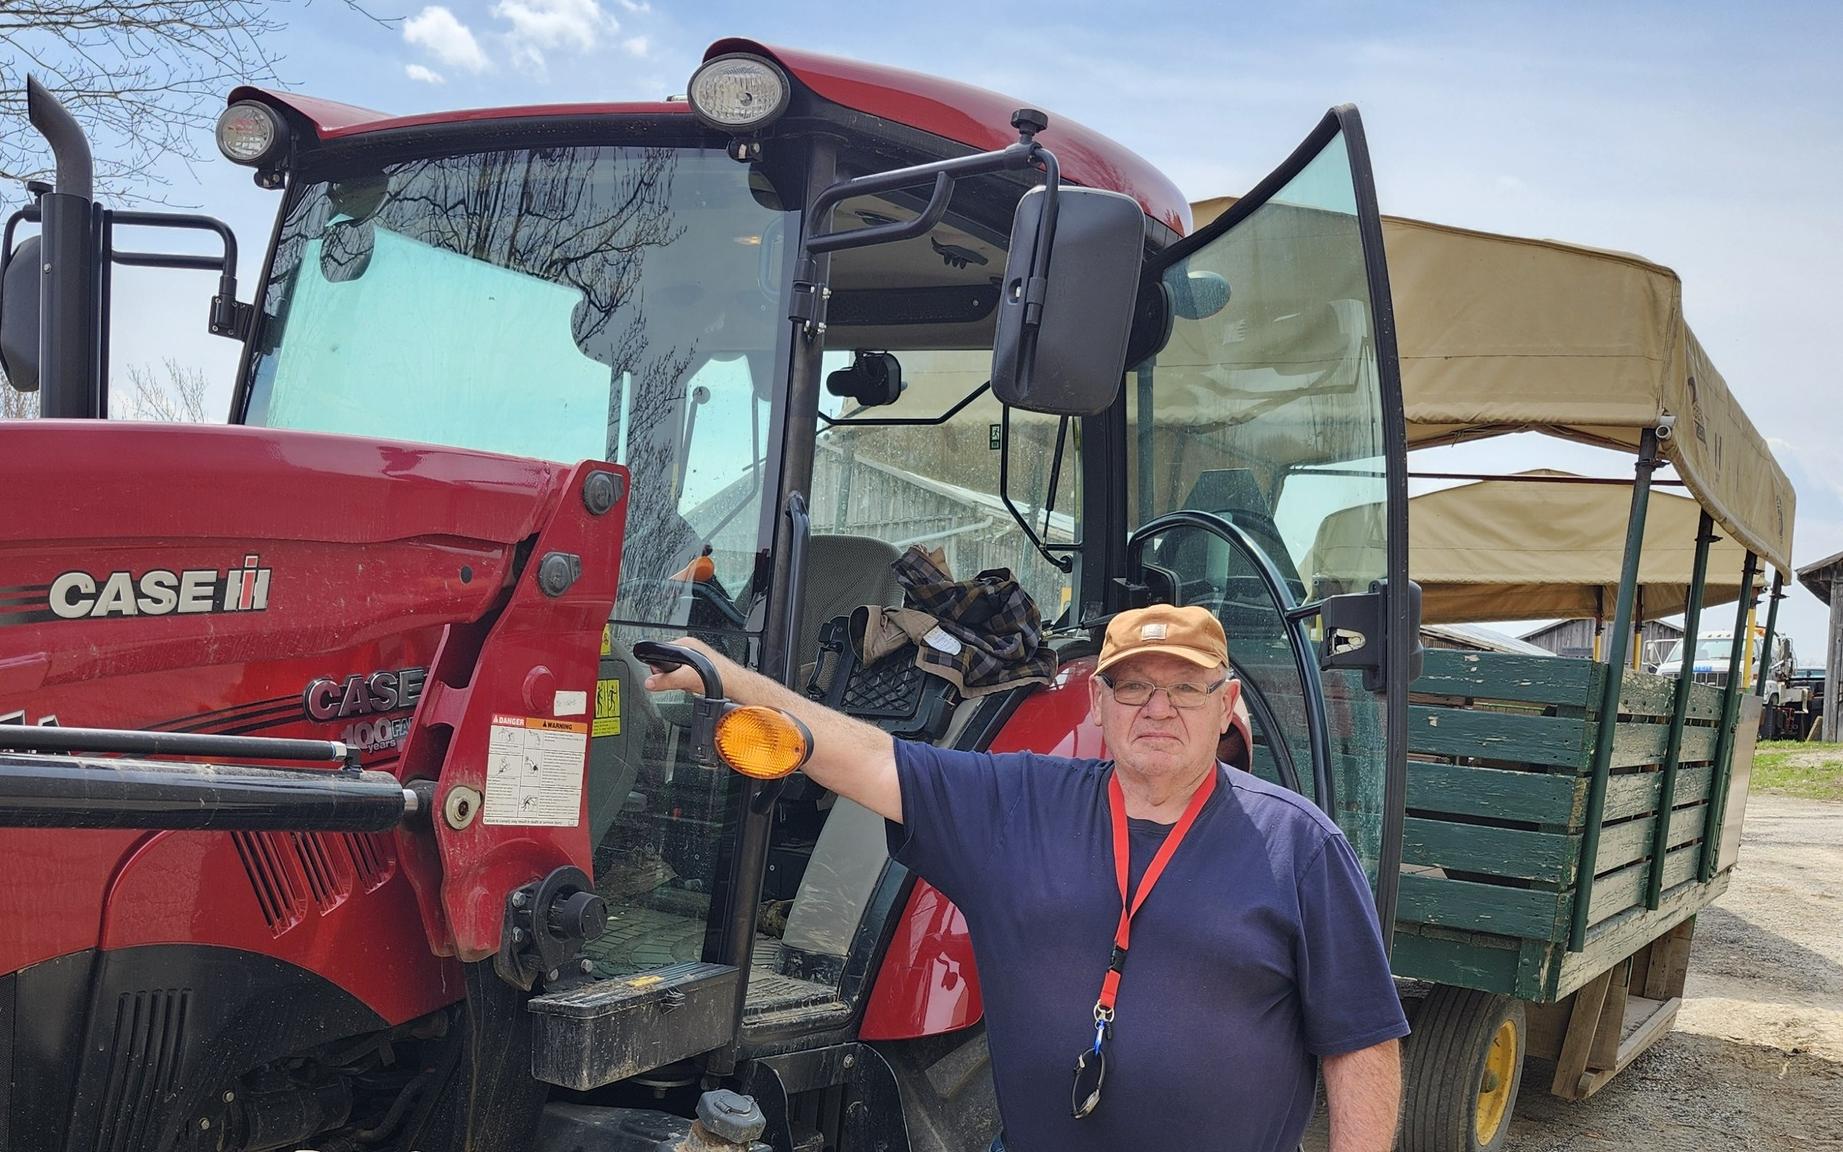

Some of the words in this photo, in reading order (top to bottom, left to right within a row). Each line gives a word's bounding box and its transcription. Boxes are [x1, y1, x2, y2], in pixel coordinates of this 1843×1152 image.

[49, 570, 218, 619] CASE
[306, 668, 425, 721] CASE
[499, 716, 525, 726] DANGER
[547, 721, 573, 730] WARNING
[341, 717, 392, 750] 100
[368, 738, 396, 753] years
